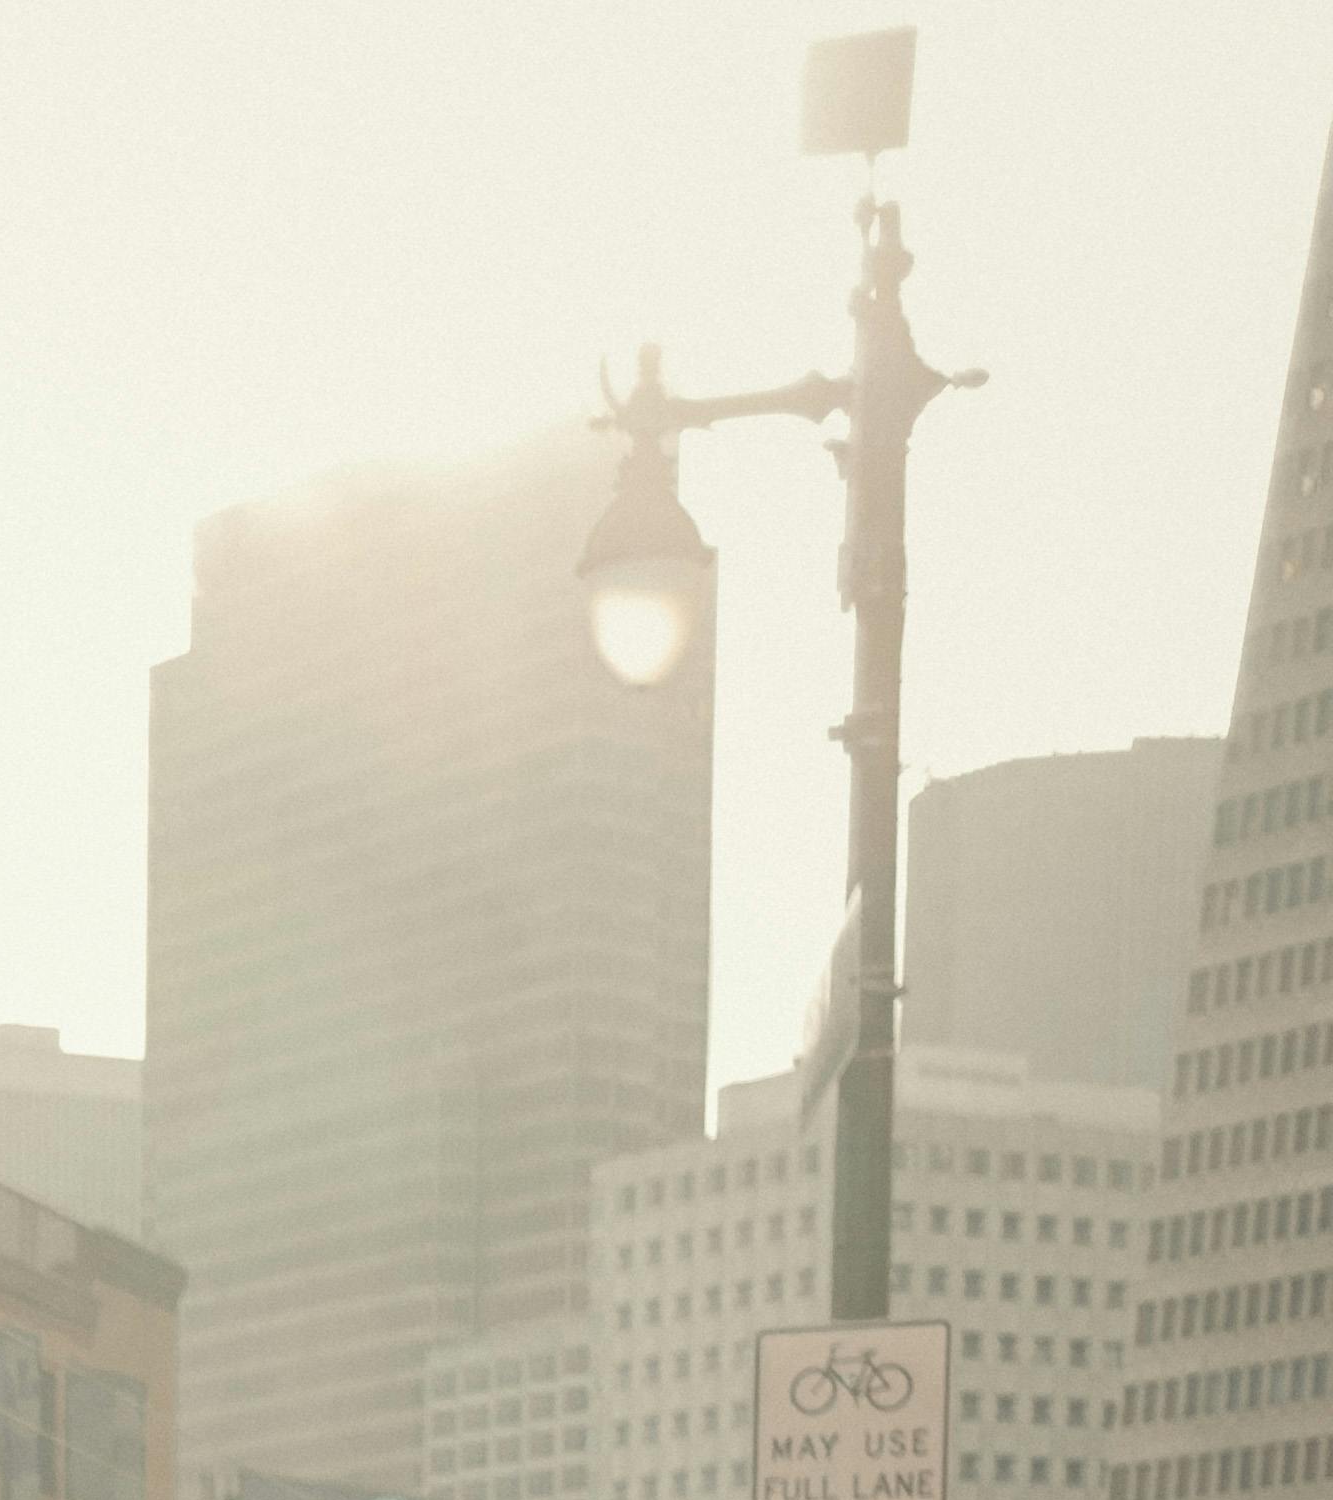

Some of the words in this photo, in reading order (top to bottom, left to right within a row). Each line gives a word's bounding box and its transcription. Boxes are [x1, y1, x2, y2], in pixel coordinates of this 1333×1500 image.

[771, 1433, 838, 1461] MAY
[865, 1427, 928, 1459] USE
[852, 1468, 934, 1500] LANE
